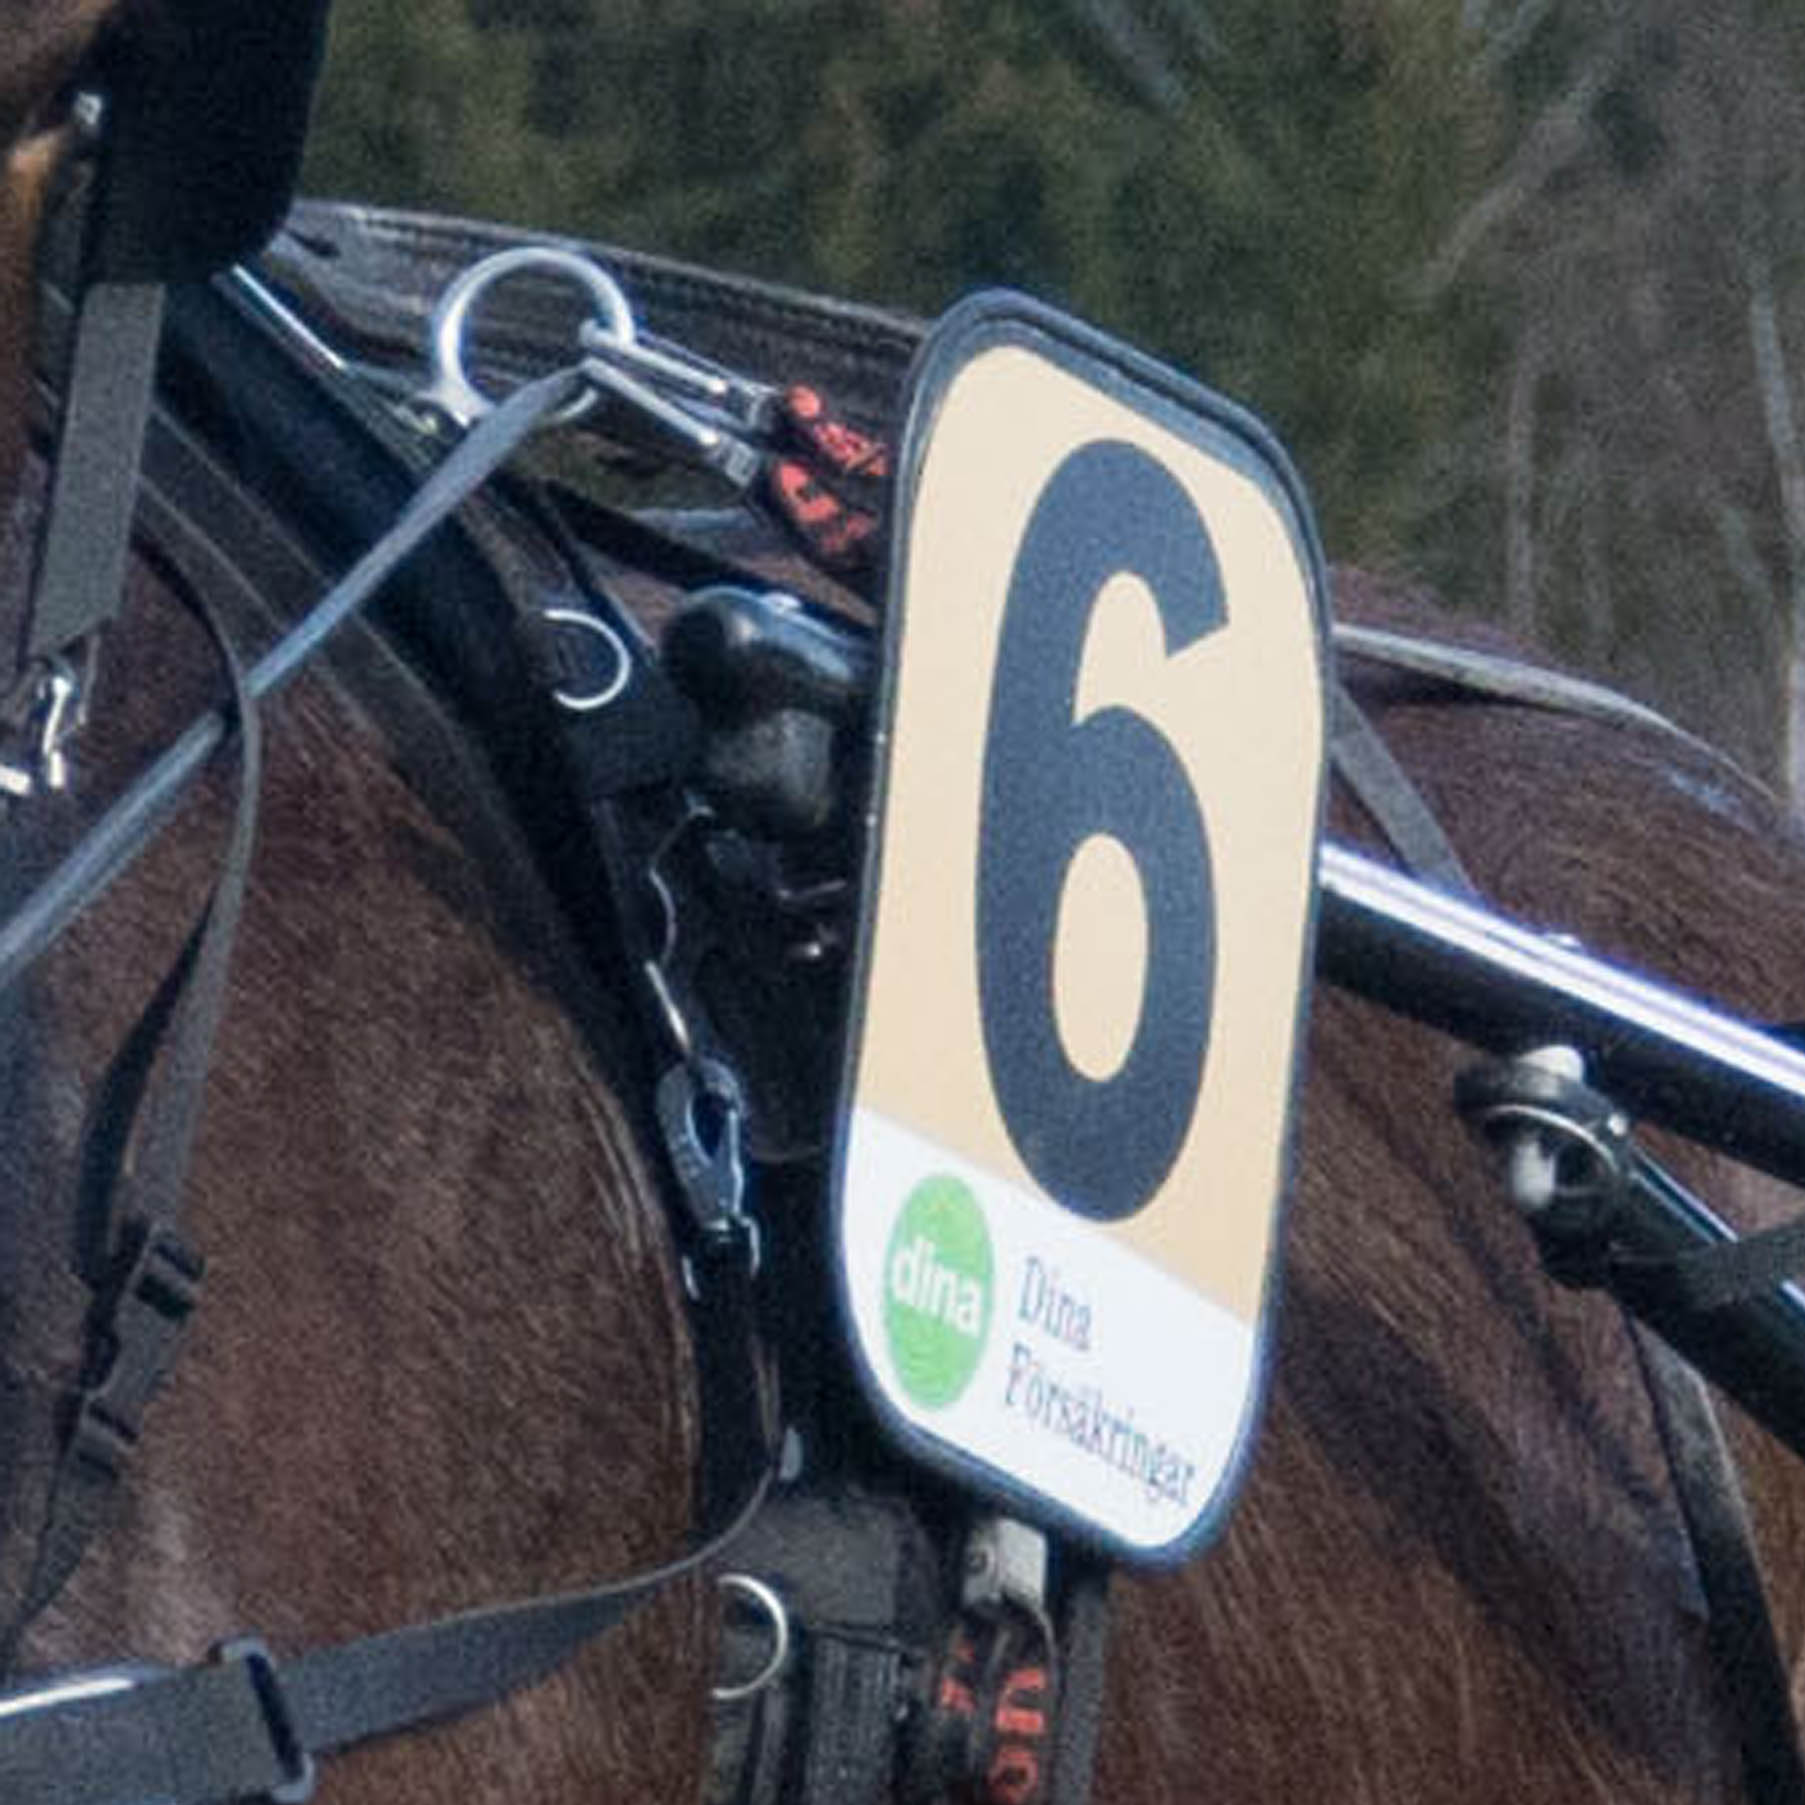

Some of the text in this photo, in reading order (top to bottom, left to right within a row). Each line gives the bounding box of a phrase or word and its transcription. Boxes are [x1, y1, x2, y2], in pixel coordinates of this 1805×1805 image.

[975, 438, 1230, 1223] 6
[892, 1236, 984, 1340] dina
[1018, 1256, 1093, 1352] Dina
